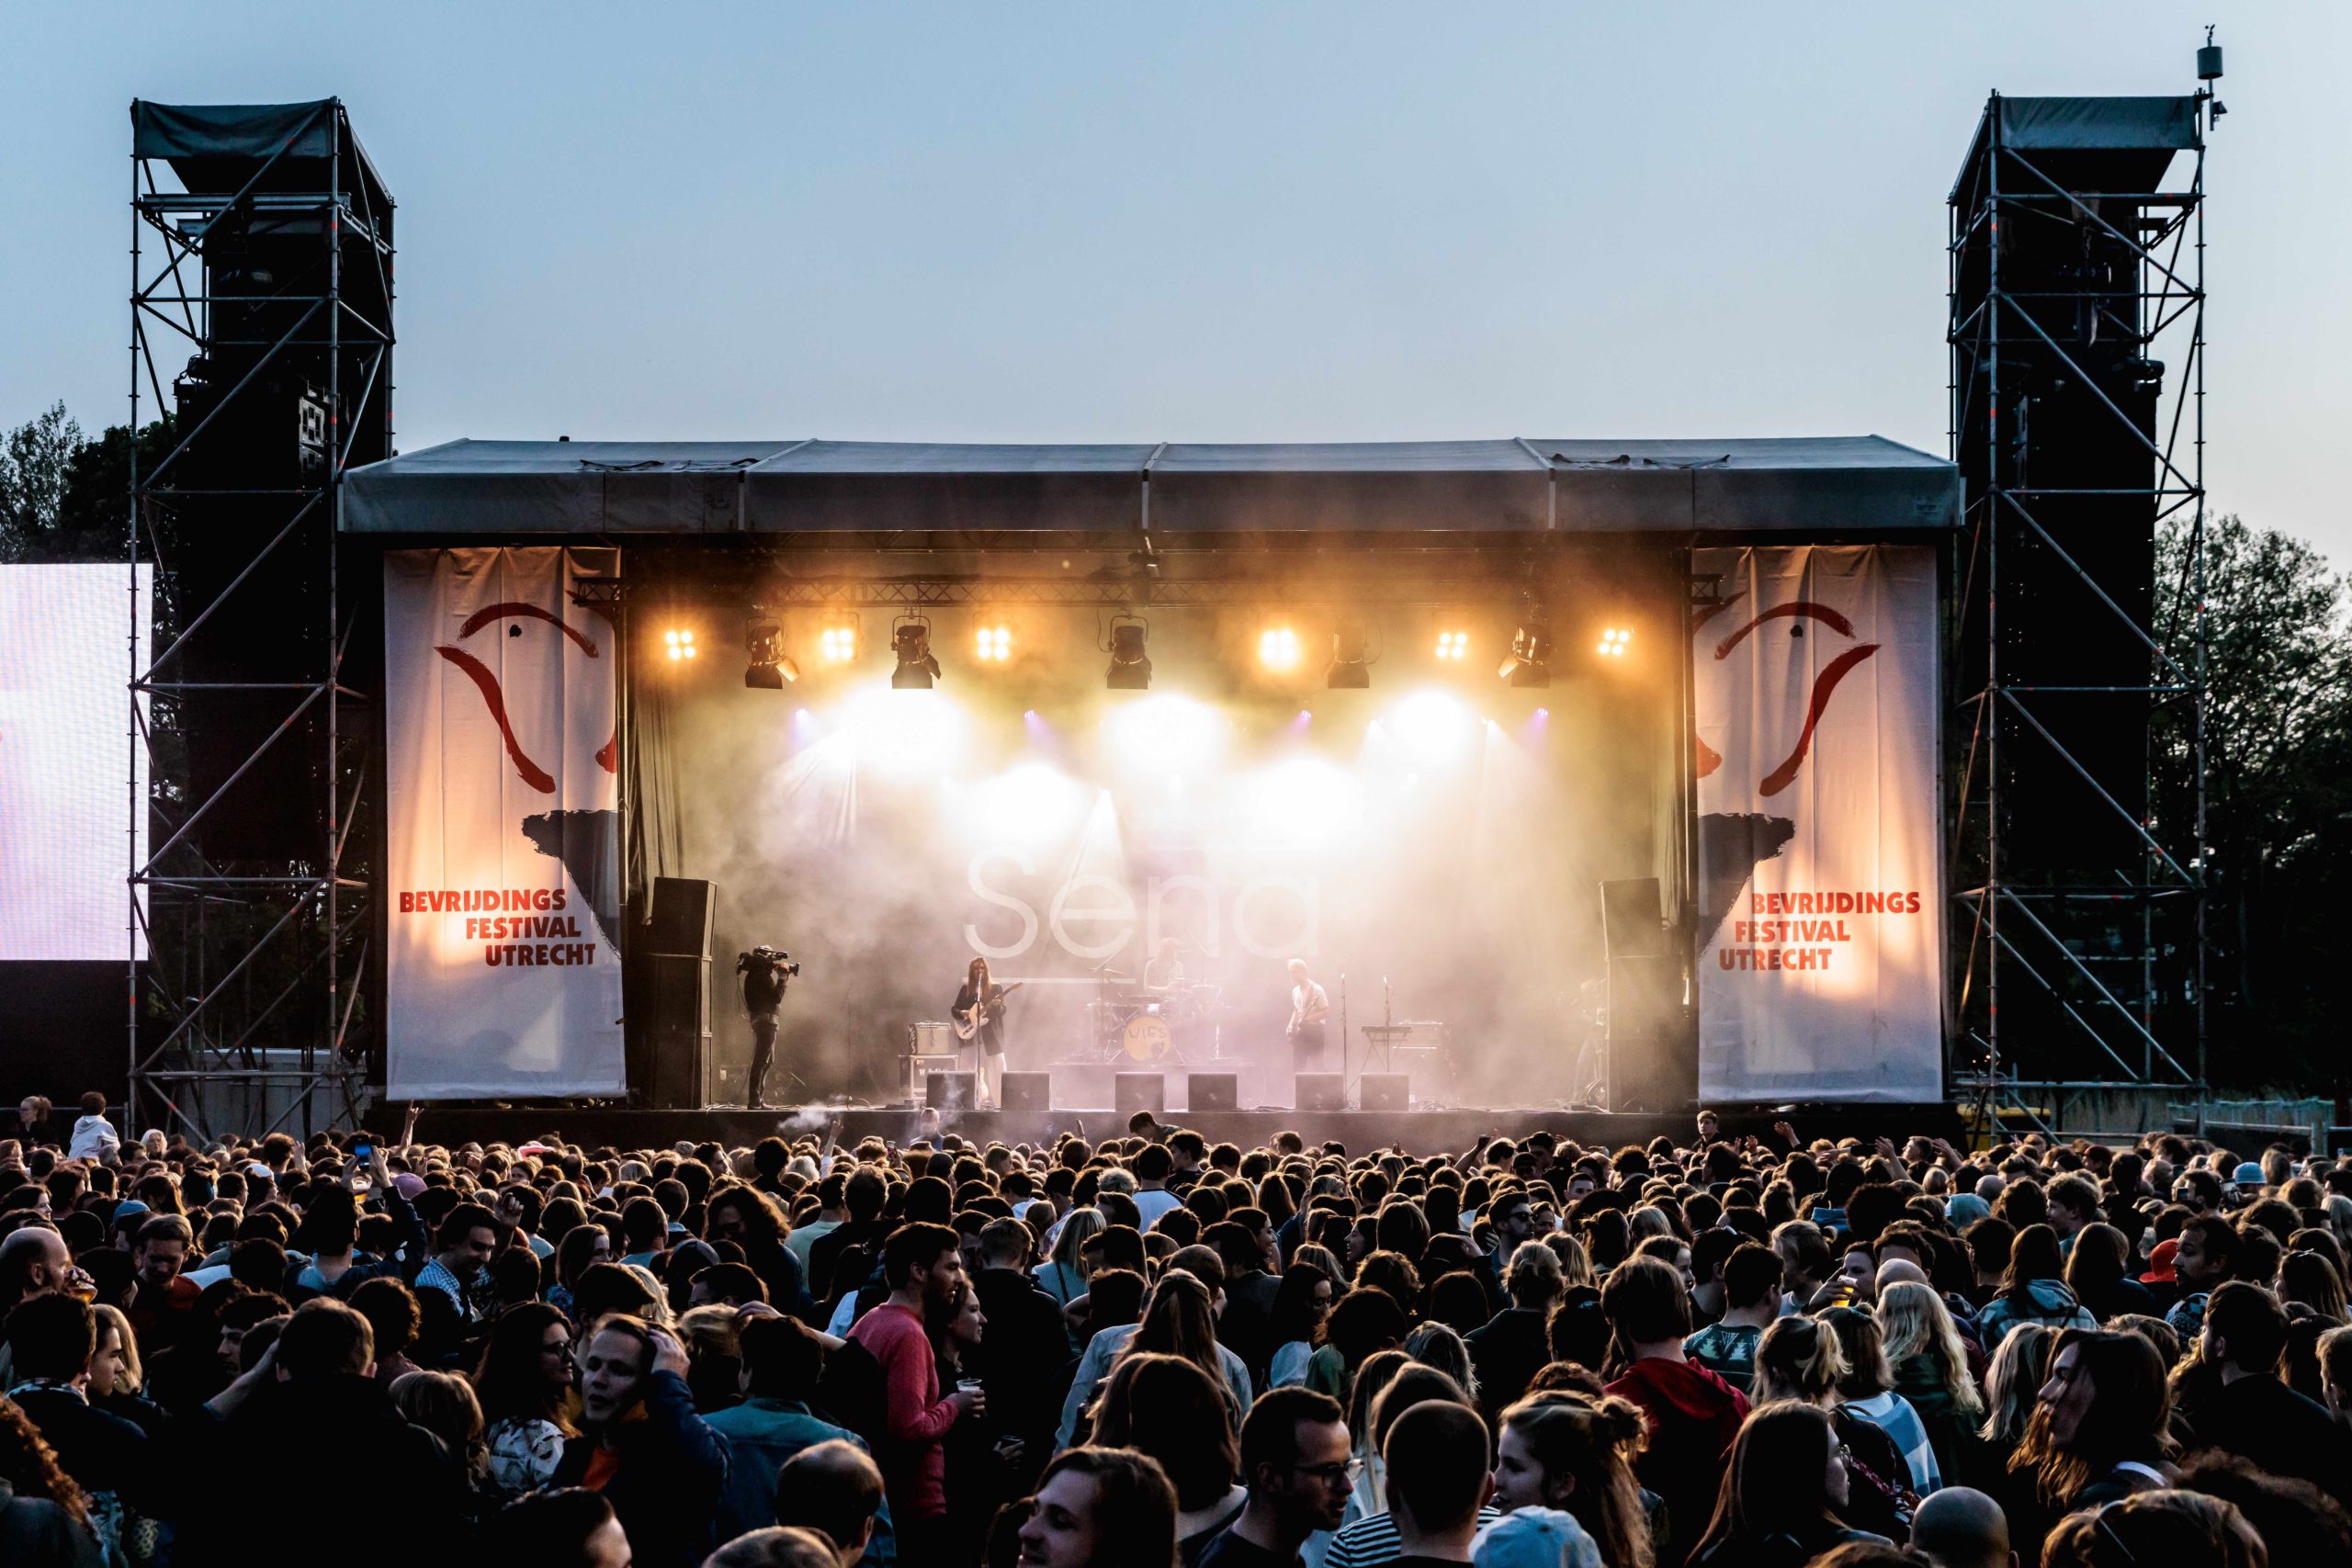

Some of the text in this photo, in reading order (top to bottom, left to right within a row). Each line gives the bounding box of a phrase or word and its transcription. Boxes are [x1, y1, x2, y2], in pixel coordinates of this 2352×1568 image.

[400, 888, 566, 913] BEVRIJDINGS
[1751, 891, 1920, 914] BEVRIJDINGS
[466, 916, 582, 939] FESTIVAL
[1735, 920, 1850, 942] FESTIVAL
[485, 942, 596, 966] UTRECHT
[1719, 948, 1832, 971] UTRECHT
[1128, 1026, 1167, 1039] WIES
